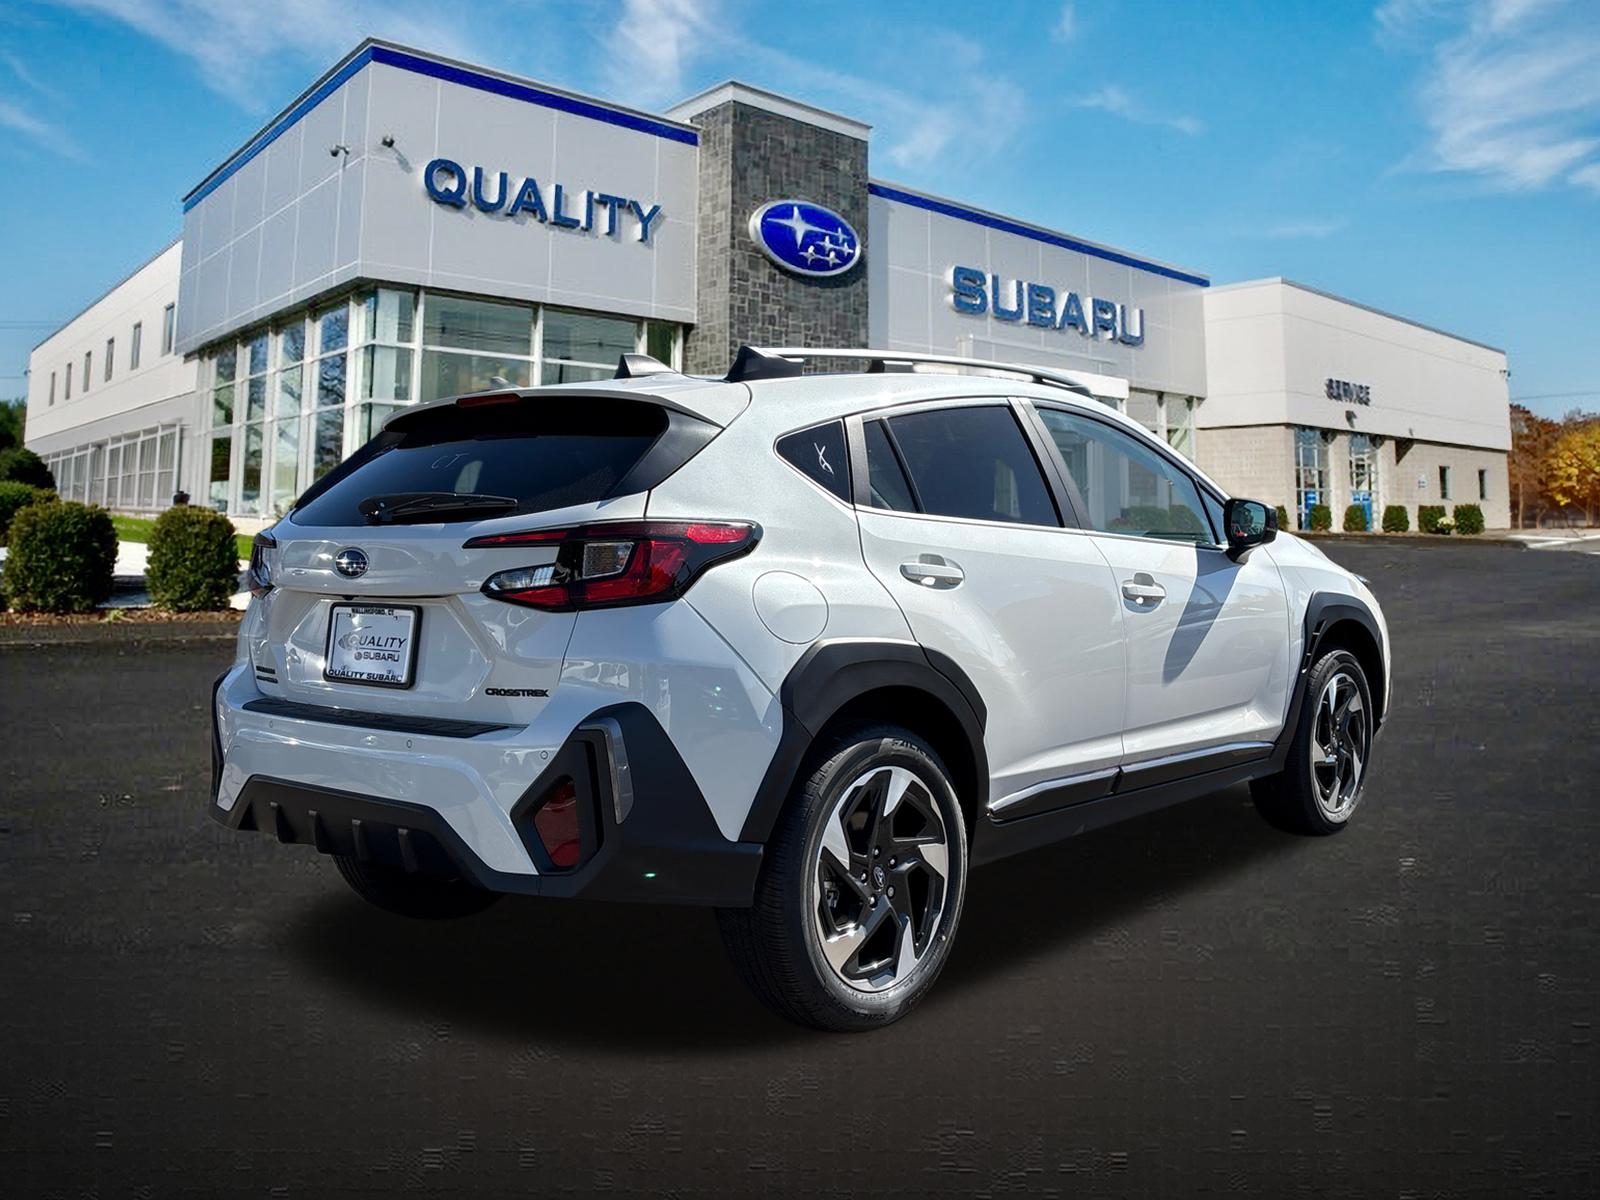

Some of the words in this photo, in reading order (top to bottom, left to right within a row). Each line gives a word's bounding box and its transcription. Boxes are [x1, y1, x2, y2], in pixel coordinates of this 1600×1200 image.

[423, 158, 662, 243] QUALITY
[951, 265, 1145, 346] SUBARU
[1326, 378, 1371, 406] SERVICE
[363, 652, 399, 662] SUBARU
[328, 669, 364, 679] QUALITY
[366, 672, 403, 682] SUBARU
[485, 688, 550, 698] CROSSTREK
